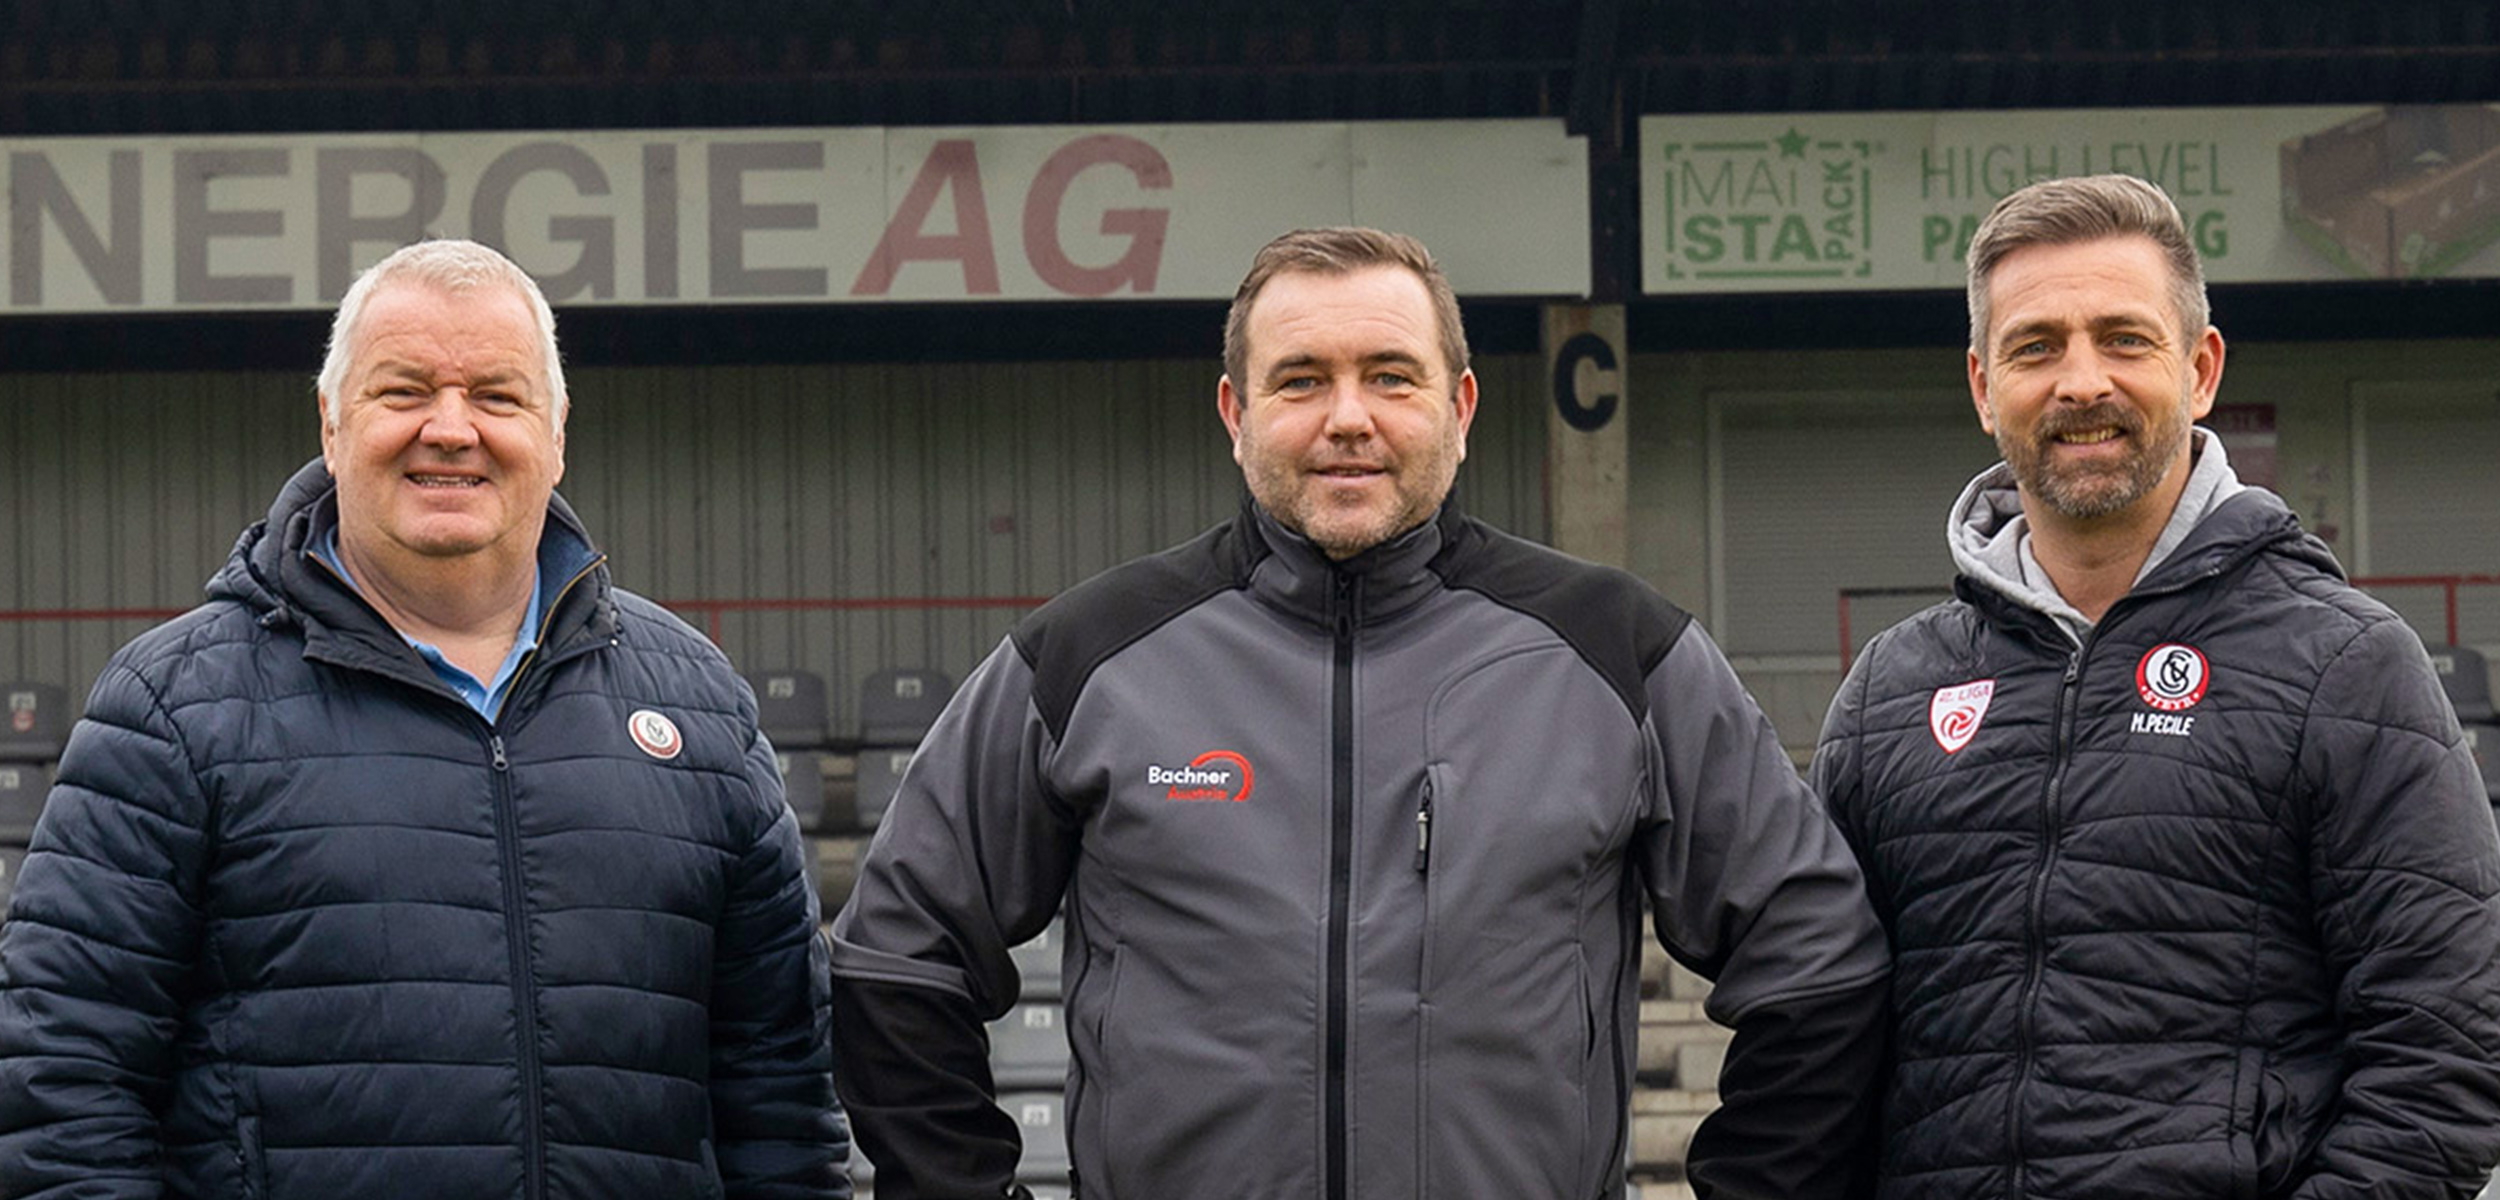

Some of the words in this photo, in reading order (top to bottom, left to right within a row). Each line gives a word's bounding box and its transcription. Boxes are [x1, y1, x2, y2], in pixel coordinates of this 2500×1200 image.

[1921, 144, 2057, 198] HIGH
[850, 134, 1175, 298] AG
[1683, 214, 1820, 263] STA
[1822, 160, 1854, 261] PACK
[1553, 333, 1618, 432] C
[1148, 766, 1230, 784] Bachner
